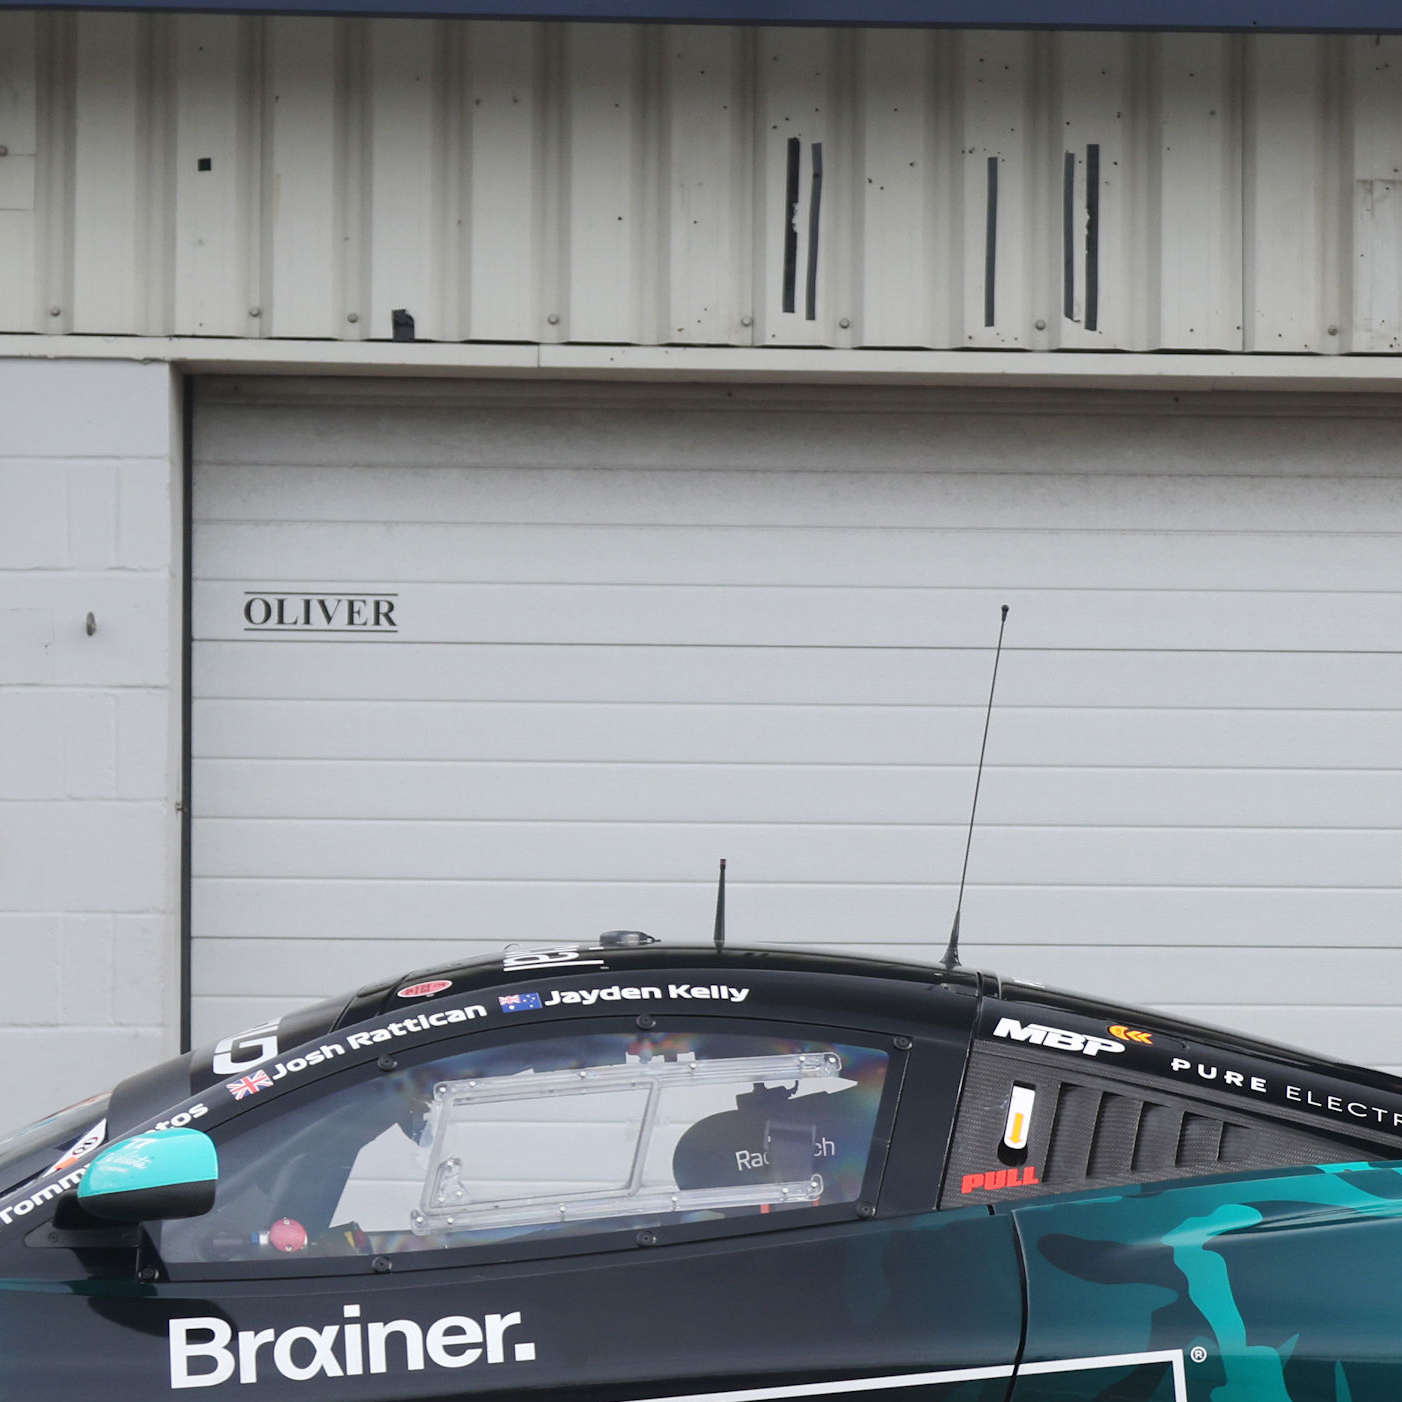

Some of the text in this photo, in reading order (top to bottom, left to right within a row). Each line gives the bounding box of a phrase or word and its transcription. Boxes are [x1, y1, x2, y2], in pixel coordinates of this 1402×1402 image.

[243, 597, 398, 627] OLIVER
[544, 983, 750, 1008] Jayden Kelly
[272, 1003, 488, 1081] Josh Rattican
[992, 1017, 1126, 1057] MBP
[1171, 1057, 1268, 1093] PURE
[961, 1166, 1040, 1194] PULL
[168, 1303, 536, 1390] Brainer.
